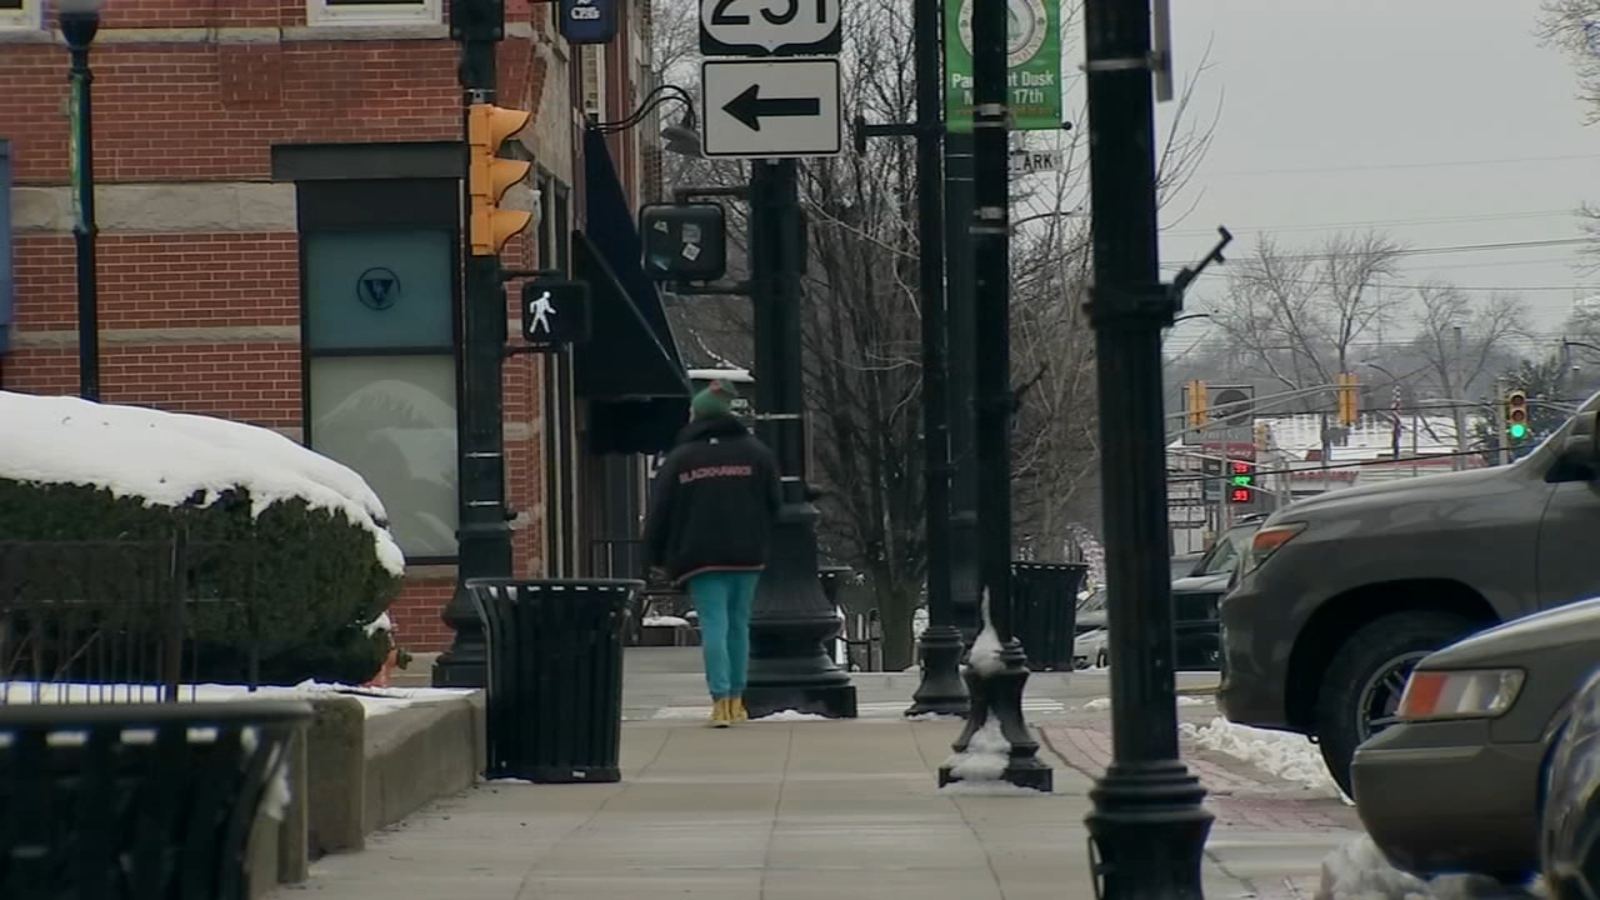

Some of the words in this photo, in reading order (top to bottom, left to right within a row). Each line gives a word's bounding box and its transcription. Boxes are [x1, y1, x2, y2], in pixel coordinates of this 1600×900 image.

[1022, 70, 1055, 87] Dusk
[1013, 88, 1044, 104] 17th
[1007, 153, 1052, 171] LARK
